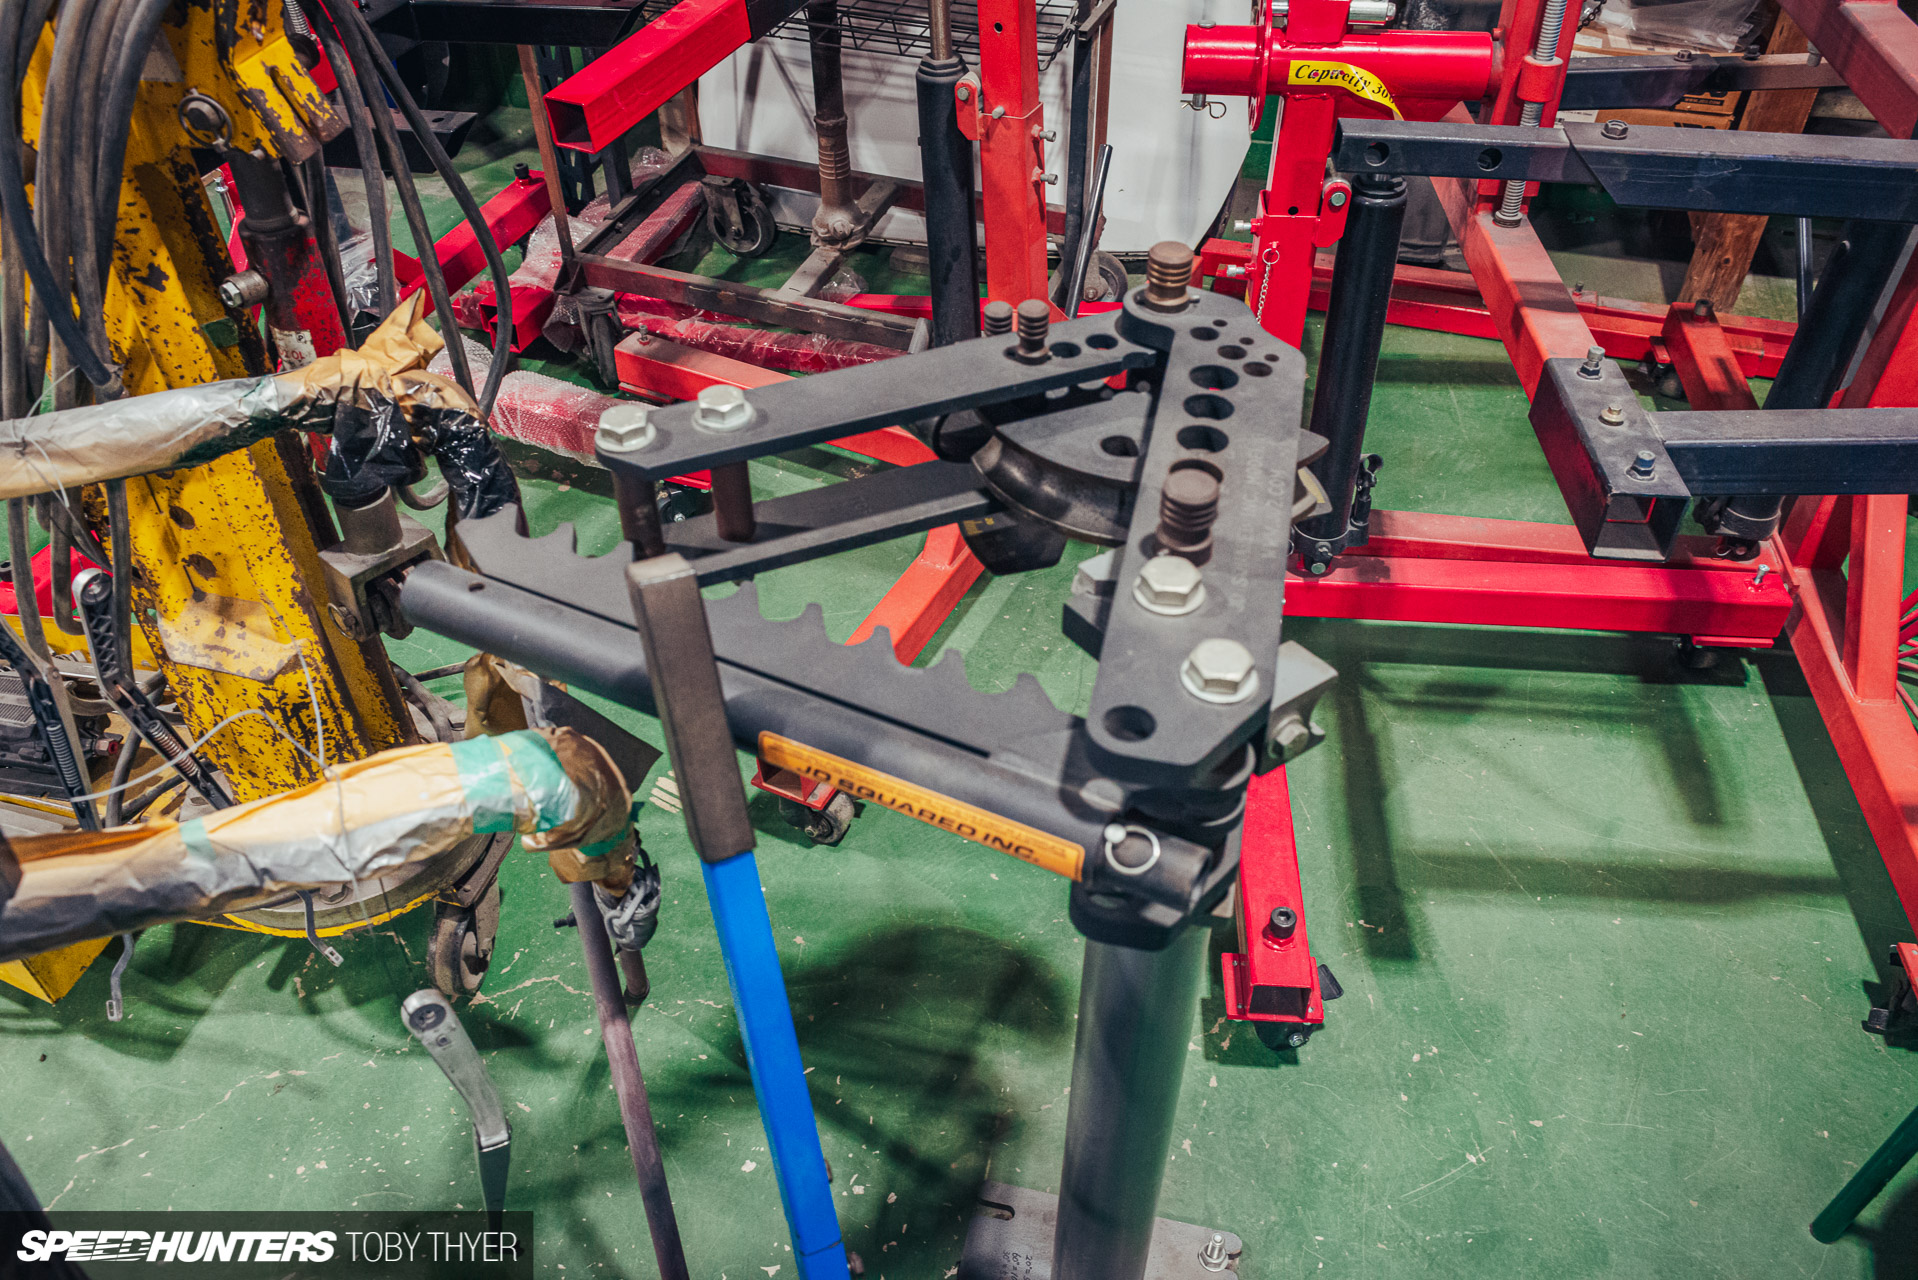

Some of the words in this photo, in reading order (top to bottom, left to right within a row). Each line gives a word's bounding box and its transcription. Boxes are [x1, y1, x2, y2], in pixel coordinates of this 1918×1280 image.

[1295, 64, 1371, 92] Capacity
[797, 765, 831, 783] JD
[838, 778, 976, 837] SQUARED
[983, 833, 1040, 863] INC.
